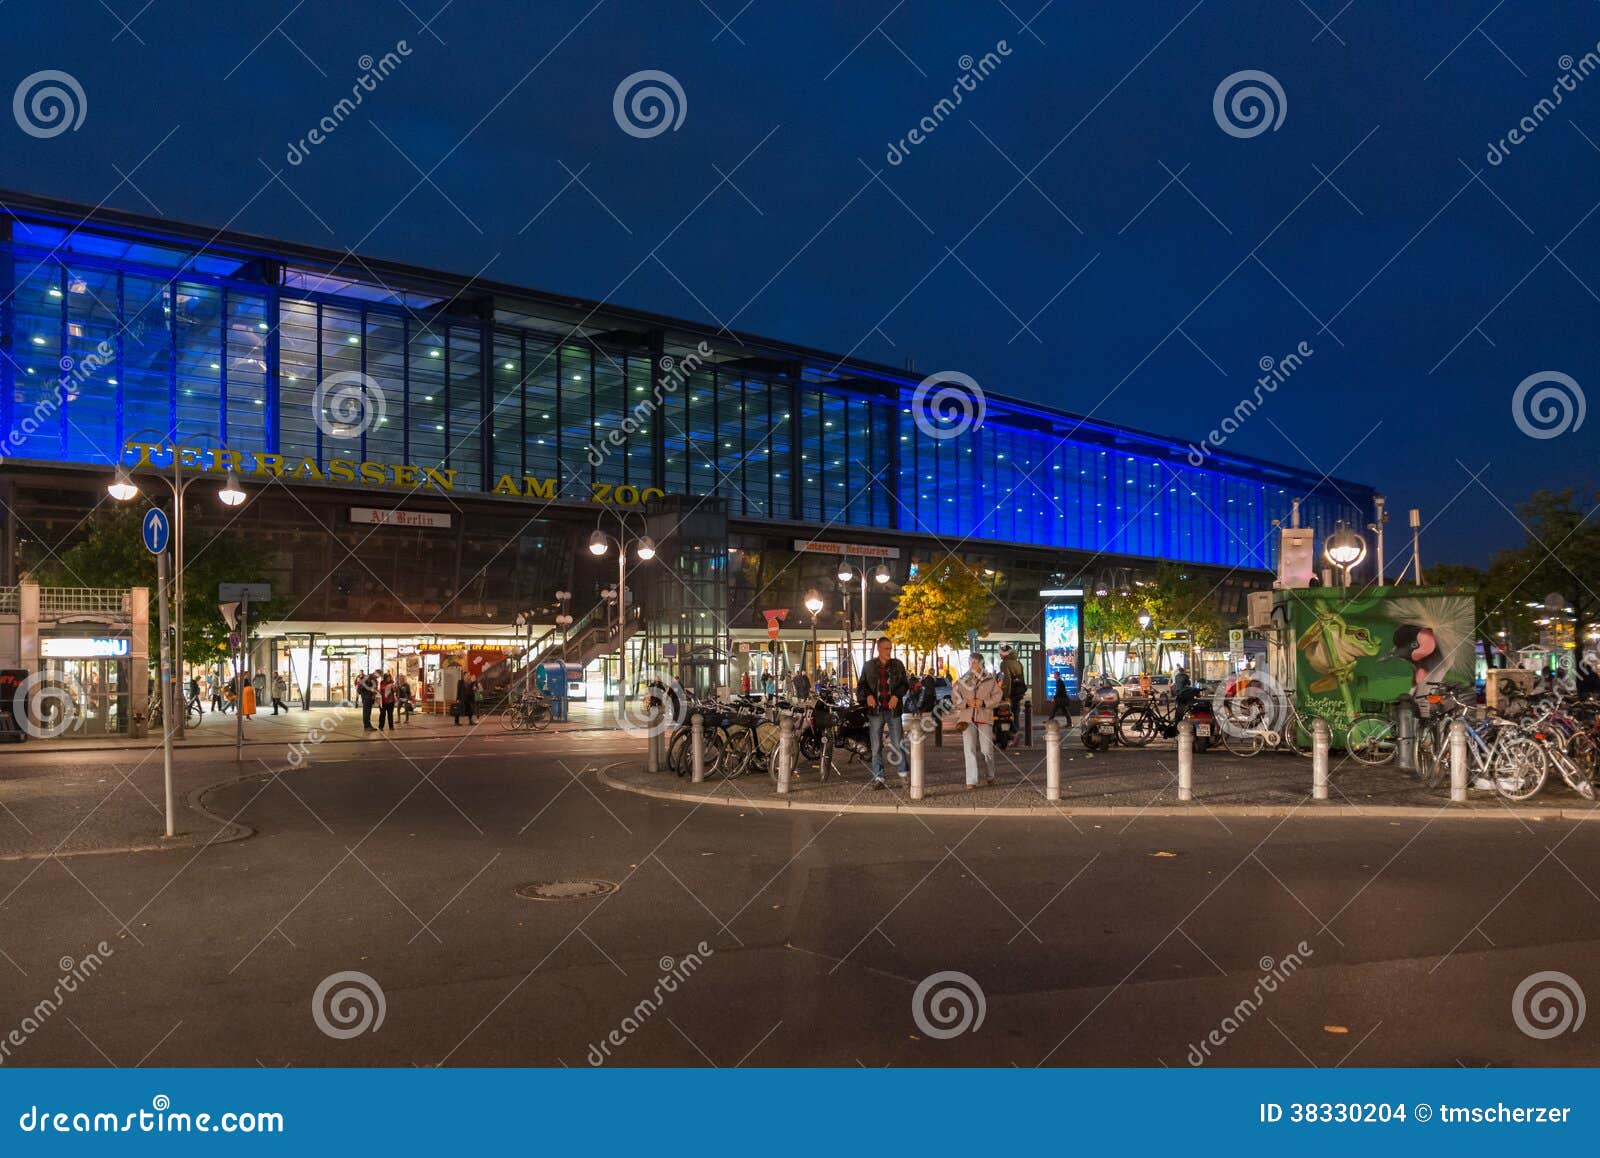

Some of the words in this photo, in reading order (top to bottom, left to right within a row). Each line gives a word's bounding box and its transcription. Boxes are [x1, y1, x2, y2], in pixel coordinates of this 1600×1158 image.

[124, 442, 458, 490] TERRASSEN
[491, 474, 558, 499] AM
[592, 483, 665, 506] ZOO
[396, 511, 433, 525] Berlin
[846, 544, 889, 556] Restaurant
